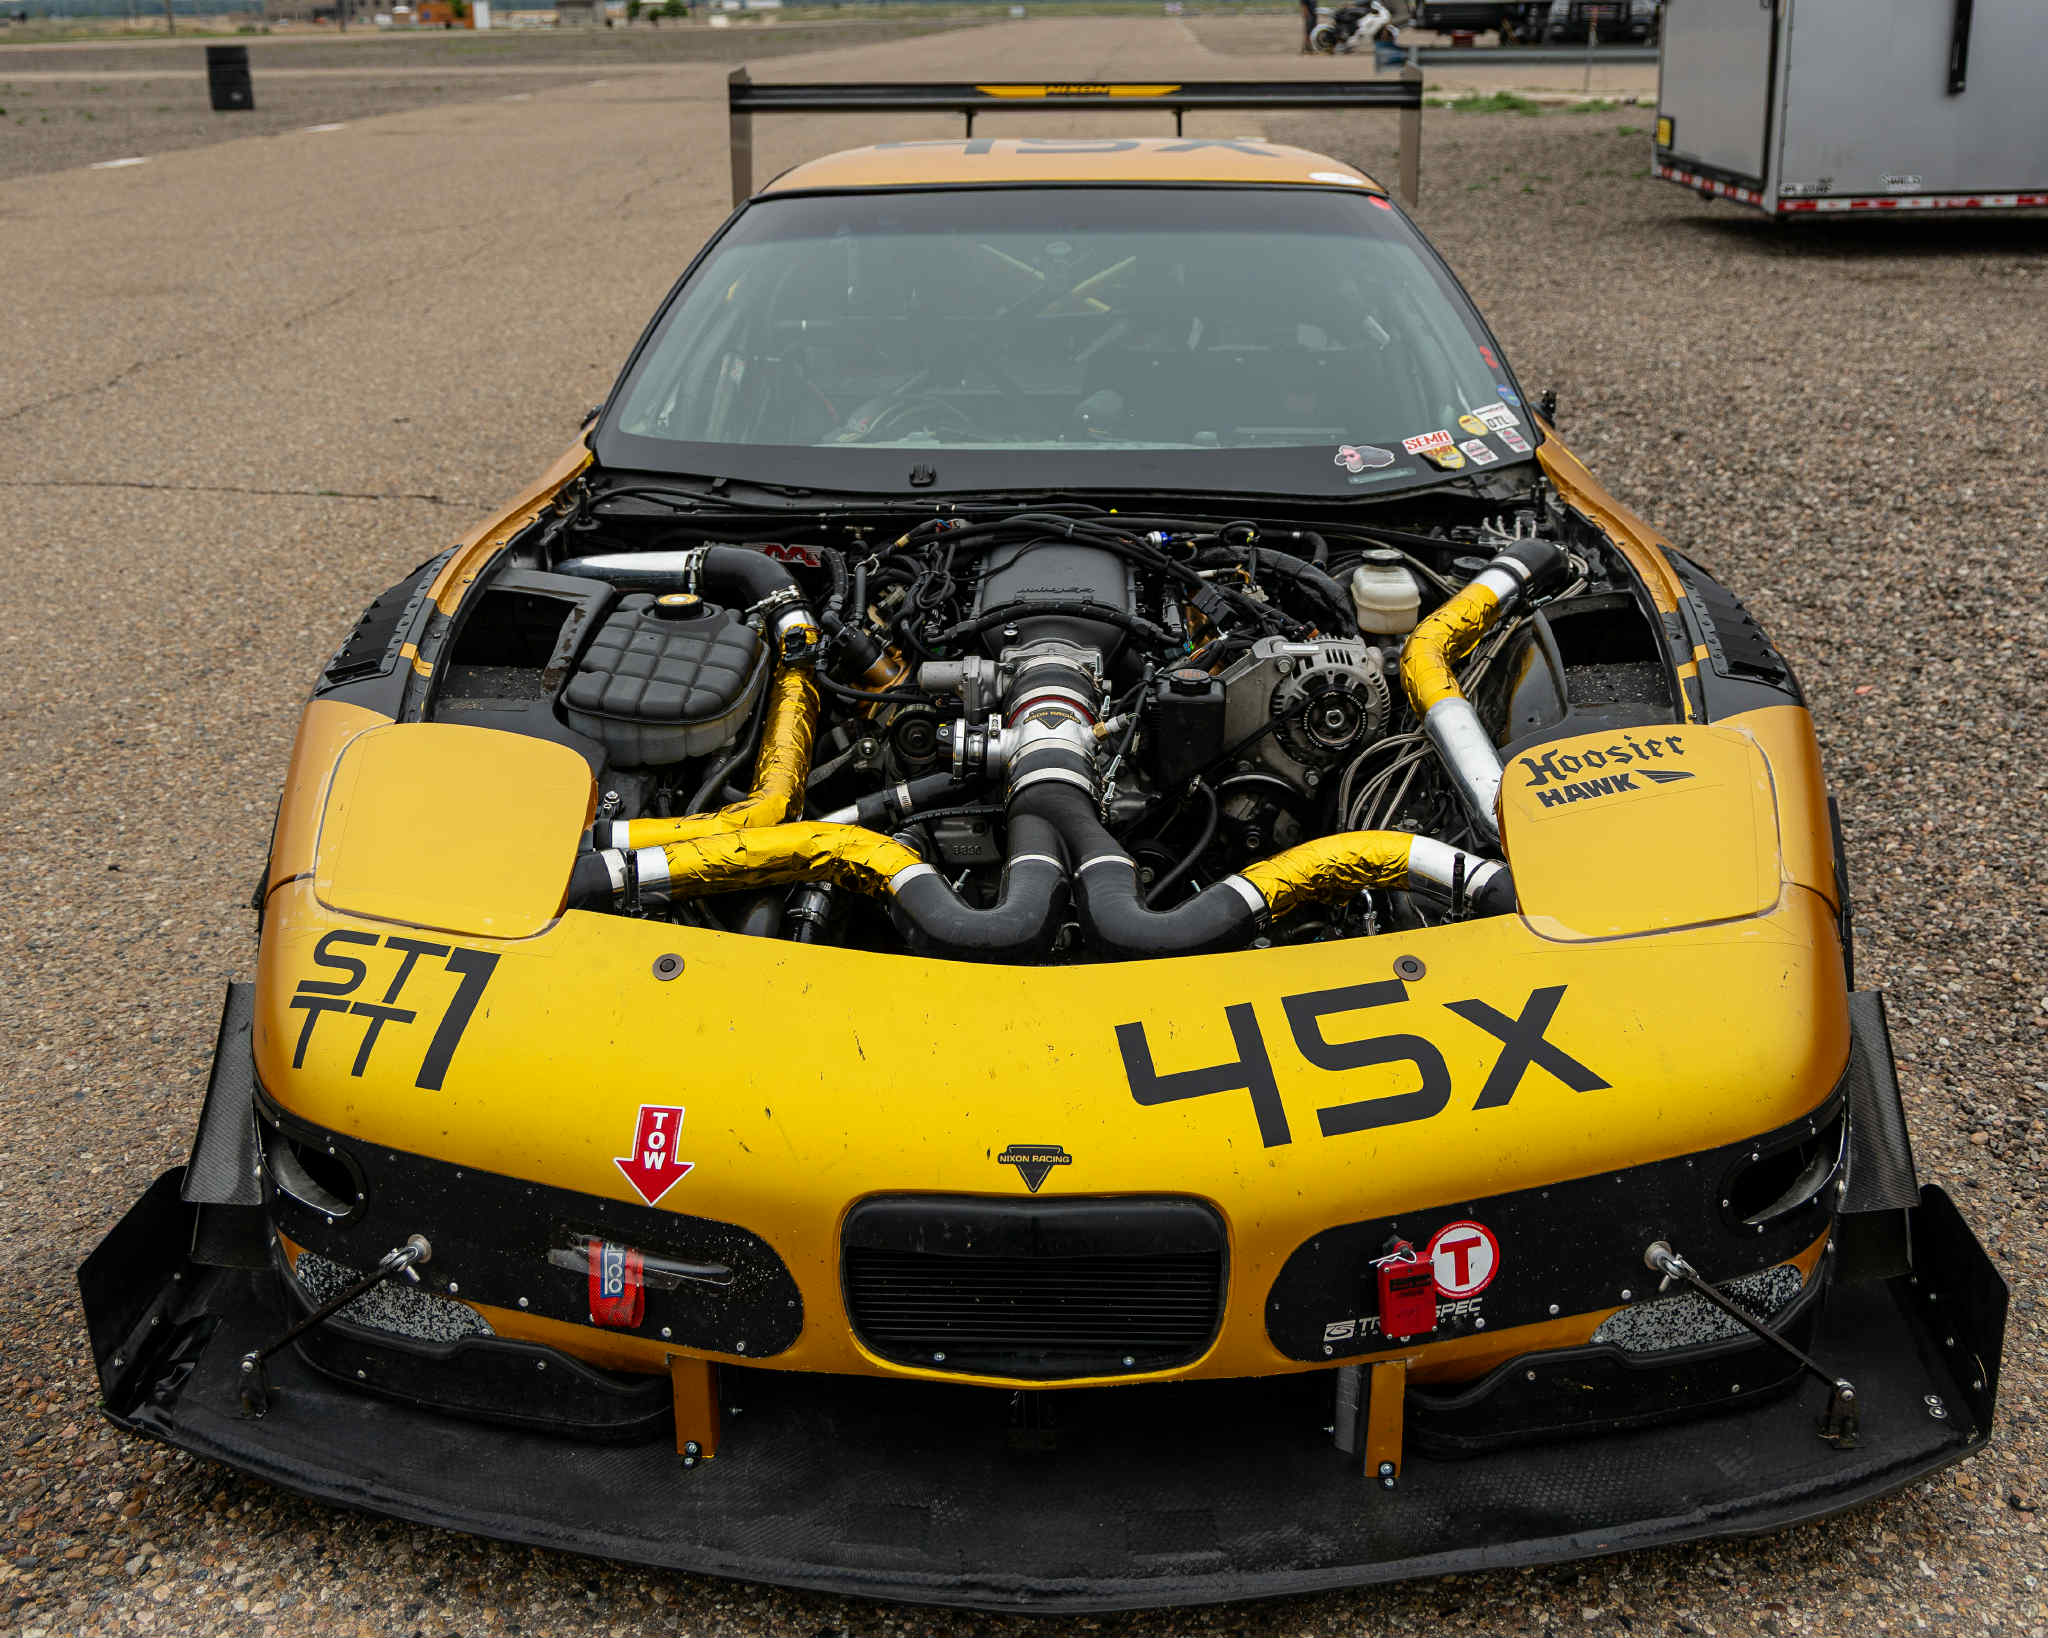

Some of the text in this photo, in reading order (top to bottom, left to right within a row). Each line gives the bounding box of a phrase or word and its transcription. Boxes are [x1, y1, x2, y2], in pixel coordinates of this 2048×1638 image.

[1519, 735, 1684, 786] Hoosier
[1536, 773, 1640, 807] HAWK
[1114, 978, 1614, 1149] 45X
[643, 1111, 669, 1170] TOW
[999, 1154, 1070, 1164] NIXON RACING
